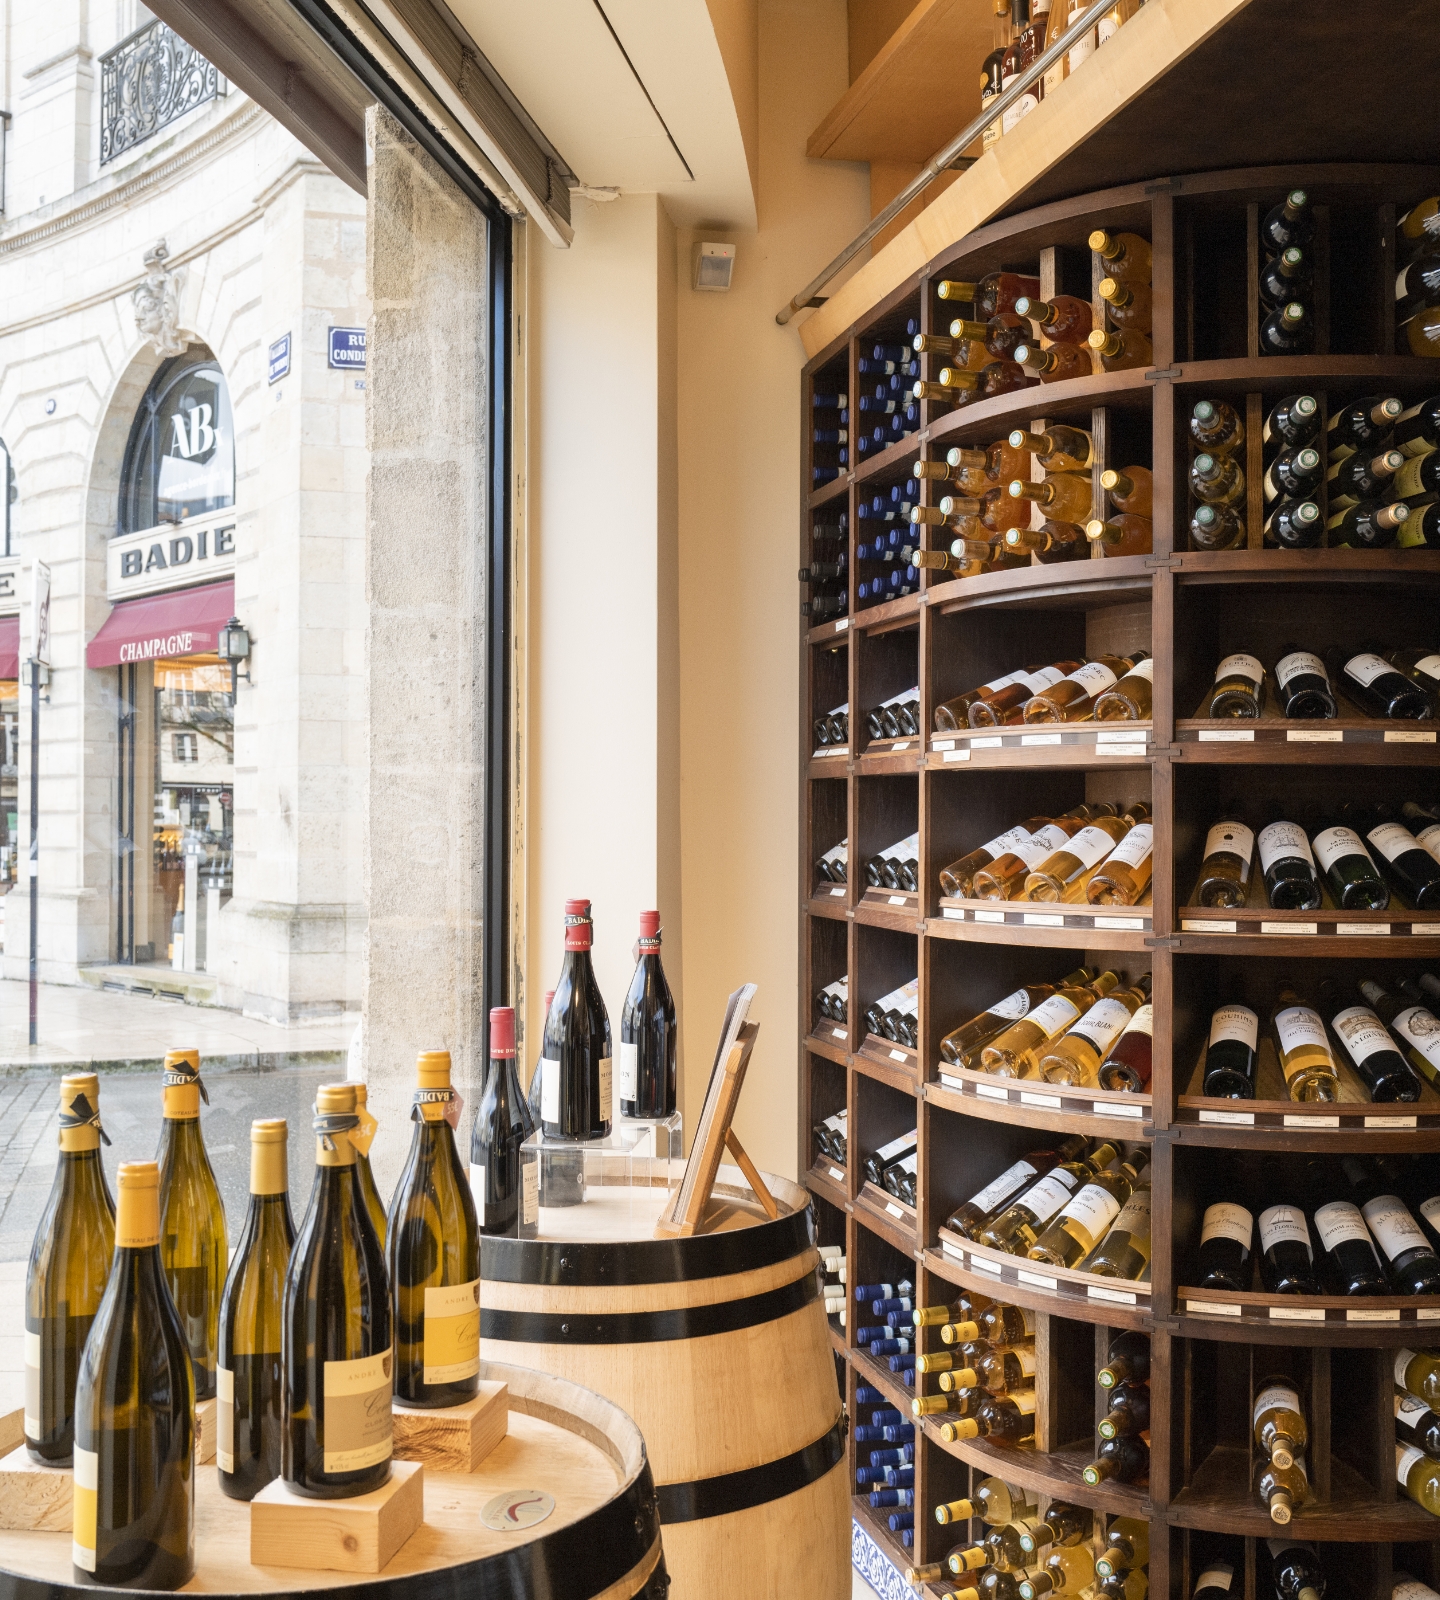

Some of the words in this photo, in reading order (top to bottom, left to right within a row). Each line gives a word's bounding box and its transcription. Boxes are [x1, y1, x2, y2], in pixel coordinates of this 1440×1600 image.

[348, 334, 366, 346] RU
[333, 349, 366, 361] CONDI
[120, 523, 236, 578] BADIE
[120, 633, 192, 661] CHAMPAGNE
[167, 1074, 194, 1085] ADIE
[418, 1091, 450, 1102] BADIE
